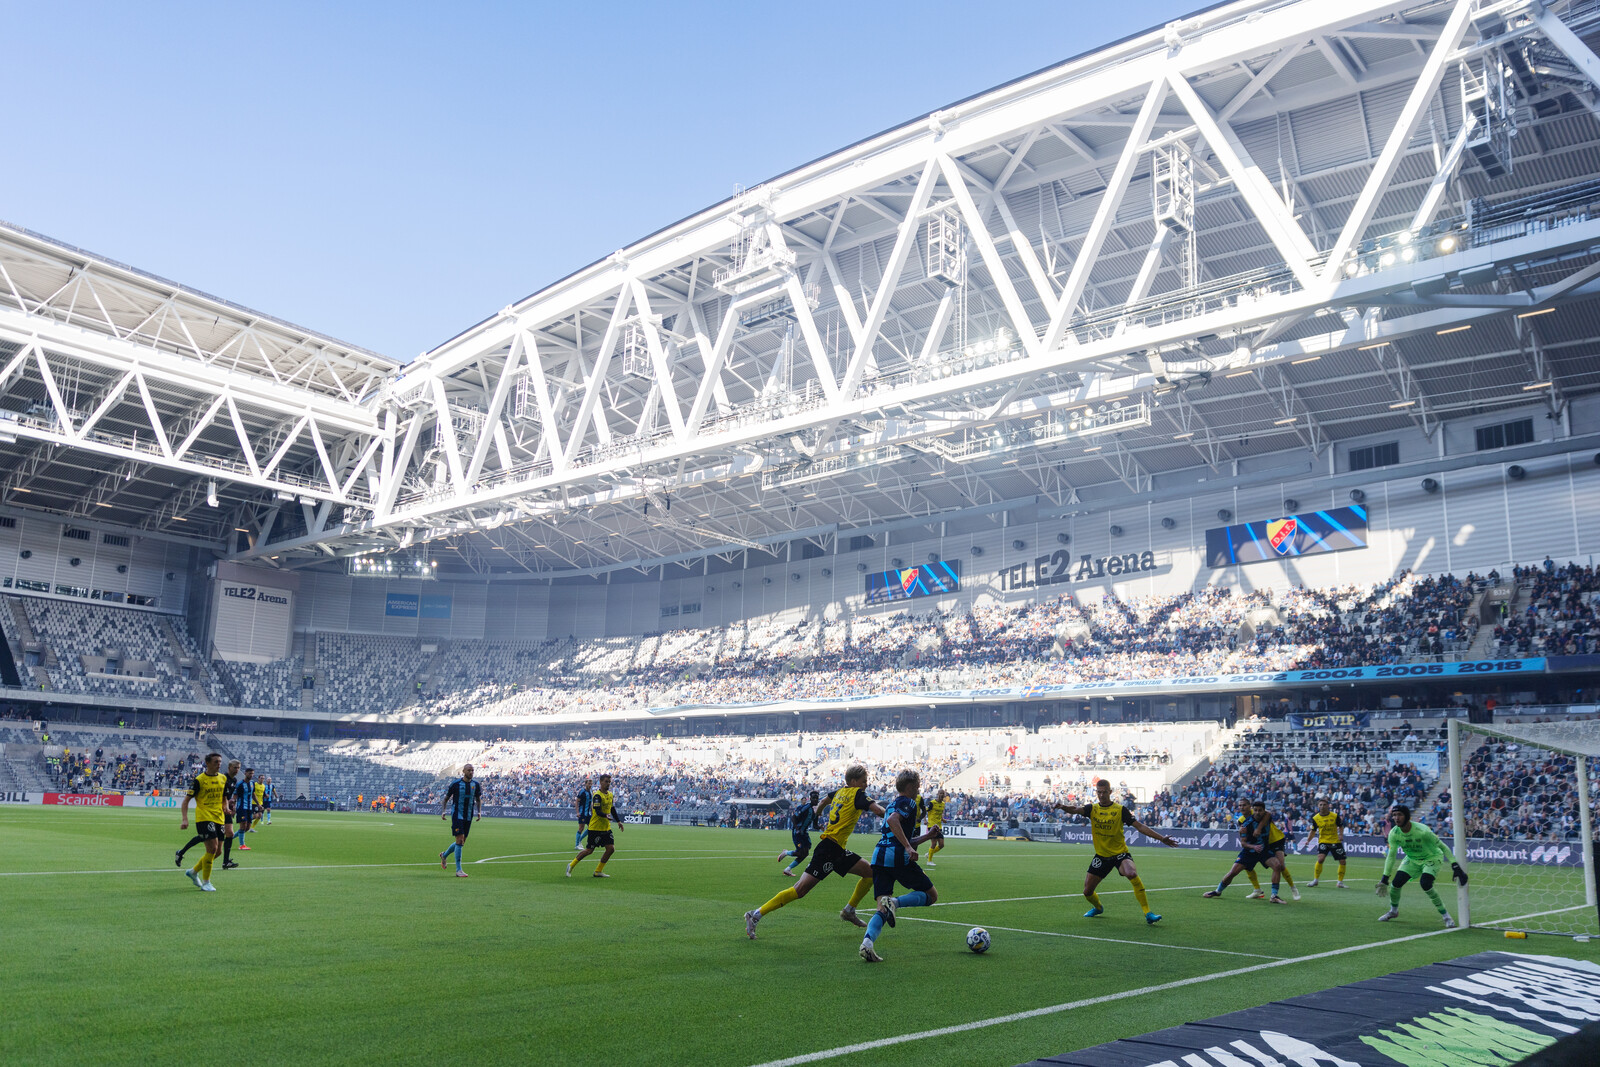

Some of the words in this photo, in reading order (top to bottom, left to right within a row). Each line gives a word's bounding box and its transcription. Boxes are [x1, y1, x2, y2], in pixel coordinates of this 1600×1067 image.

[998, 549, 1071, 591] TELE2
[1076, 550, 1158, 581] Arena
[224, 587, 256, 600] TELE2
[257, 592, 288, 604] Arena
[969, 688, 1011, 696] 2003
[1073, 682, 1116, 690] 2019
[1171, 677, 1219, 685] 1990
[1229, 673, 1288, 683] 2002
[1300, 669, 1364, 680] 2004
[1376, 665, 1444, 677] 2005
[1458, 661, 1523, 673] 2018
[1303, 716, 1328, 727] DIF
[1329, 715, 1355, 726] VIP
[57, 793, 110, 806] Scandic
[144, 796, 177, 808] Ocab
[623, 814, 652, 824] stadium
[943, 826, 966, 836] BILL
[1064, 831, 1093, 841] Nordm
